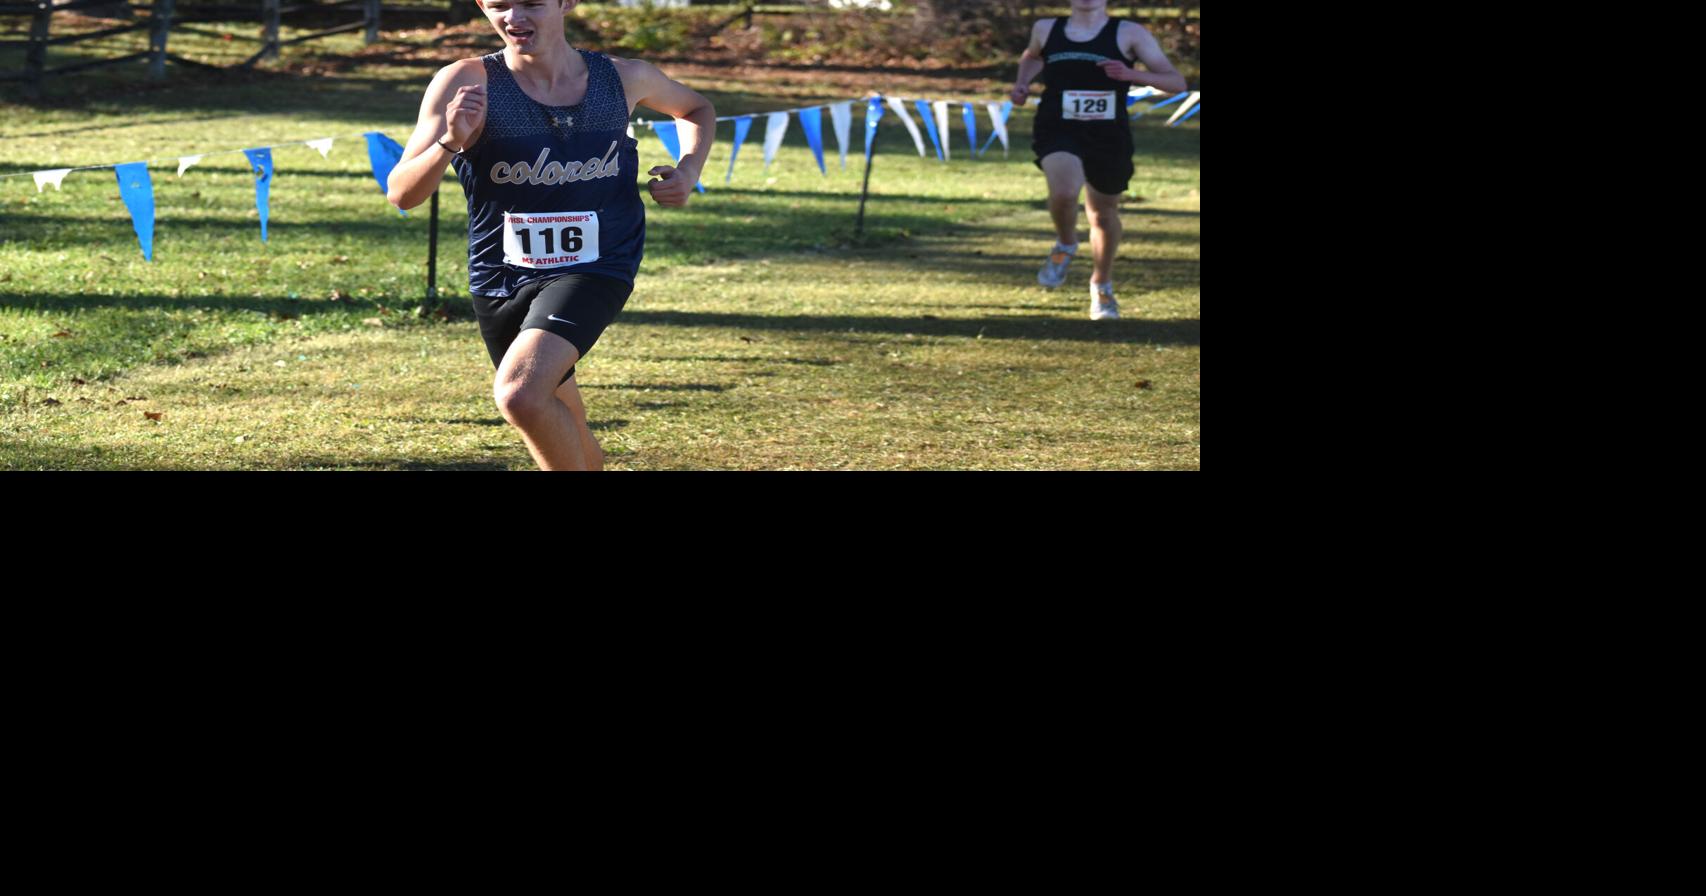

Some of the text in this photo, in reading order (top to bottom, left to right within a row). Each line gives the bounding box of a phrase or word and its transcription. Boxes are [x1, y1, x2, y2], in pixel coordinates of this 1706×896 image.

[1072, 98, 1108, 113] 129
[489, 140, 620, 185] colonels
[527, 215, 590, 224] CHAMPIONSHIPS
[515, 226, 583, 255] 116
[535, 255, 579, 265] ATHLETIC
